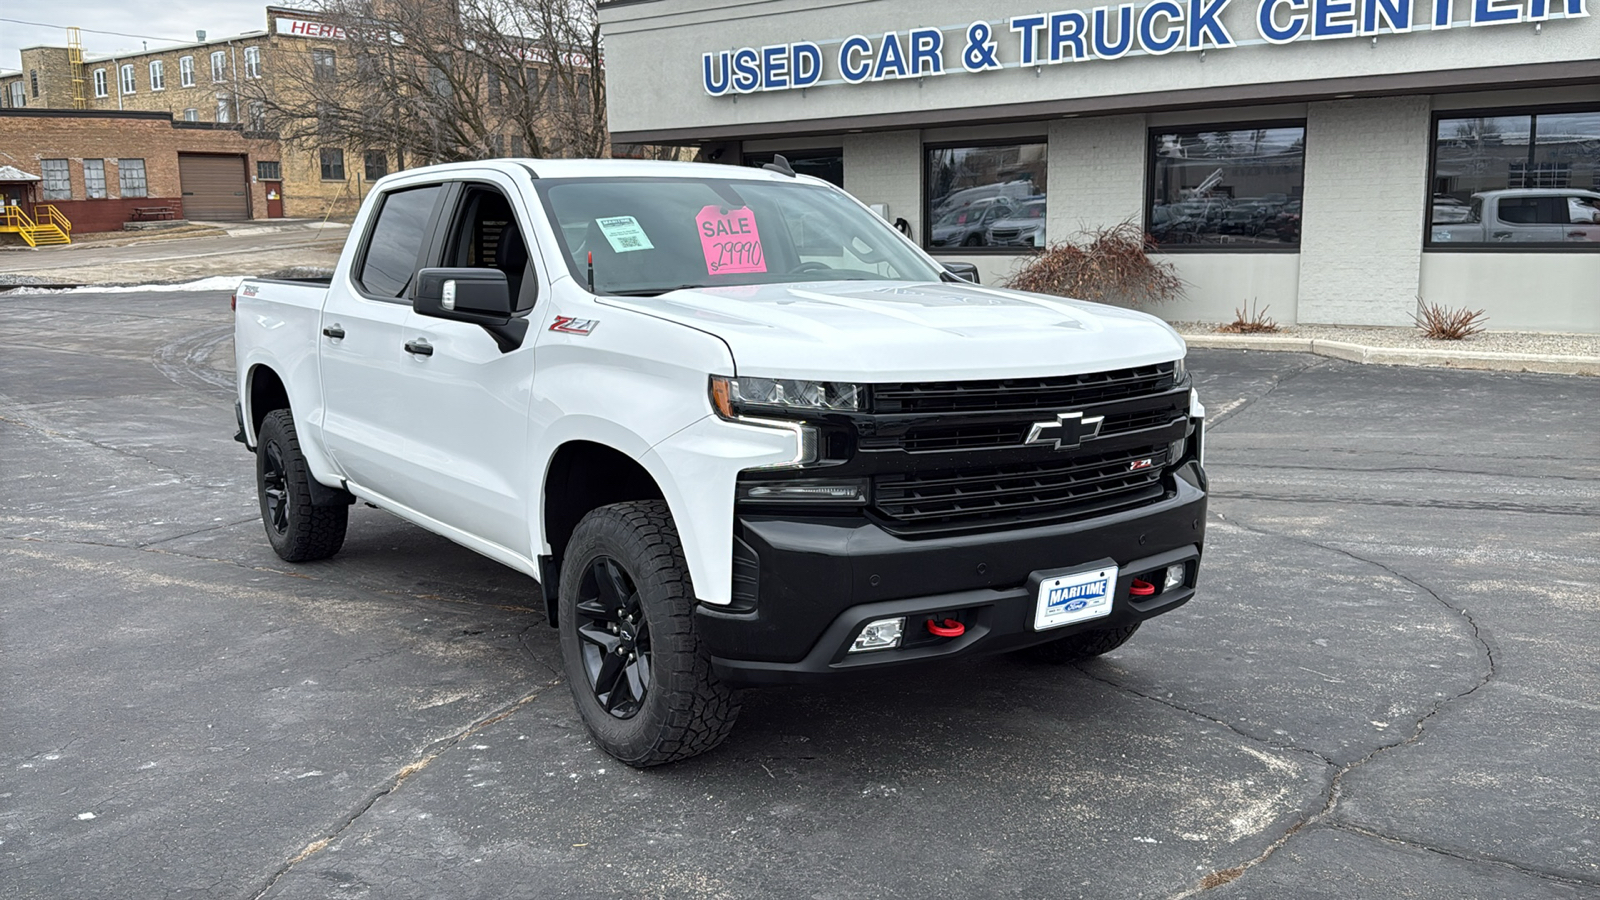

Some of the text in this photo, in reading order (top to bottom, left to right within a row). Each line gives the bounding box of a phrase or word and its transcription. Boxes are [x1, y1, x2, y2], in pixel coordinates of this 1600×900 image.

[702, 40, 823, 97] USED
[839, 26, 945, 84] CAR
[961, 20, 1003, 73] &
[1010, 0, 1237, 69] TRUCK
[702, 217, 752, 237] SALE
[548, 315, 600, 336] Z71
[1050, 580, 1107, 606] MARITIME
[1066, 600, 1086, 611] Ford
